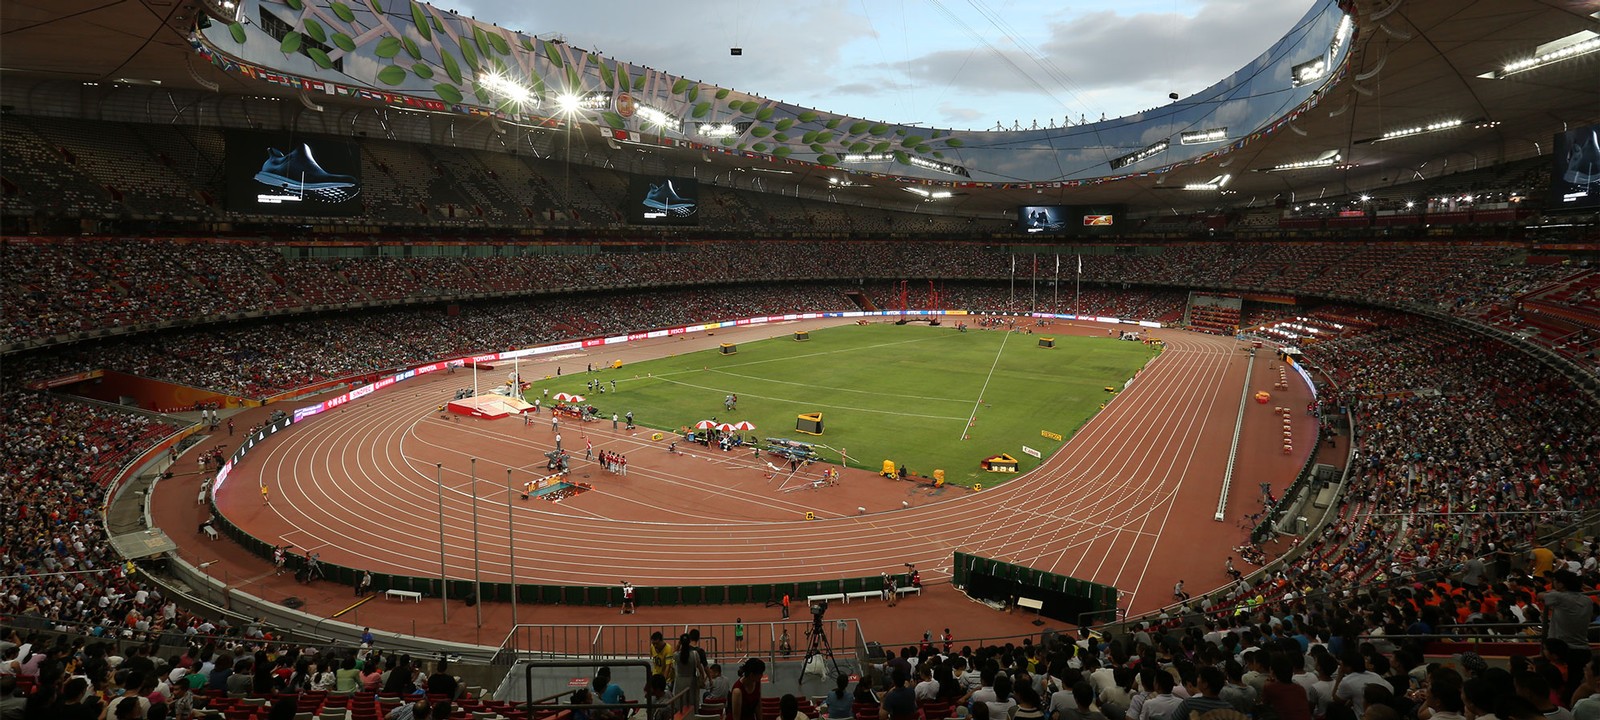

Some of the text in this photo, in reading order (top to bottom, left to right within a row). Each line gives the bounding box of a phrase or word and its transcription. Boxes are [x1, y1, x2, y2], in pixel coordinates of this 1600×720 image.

[472, 354, 496, 362] TOYOTA
[444, 359, 464, 368] TOTA
[418, 365, 437, 374] TOYOTA
[352, 385, 371, 398] SINOPEC
